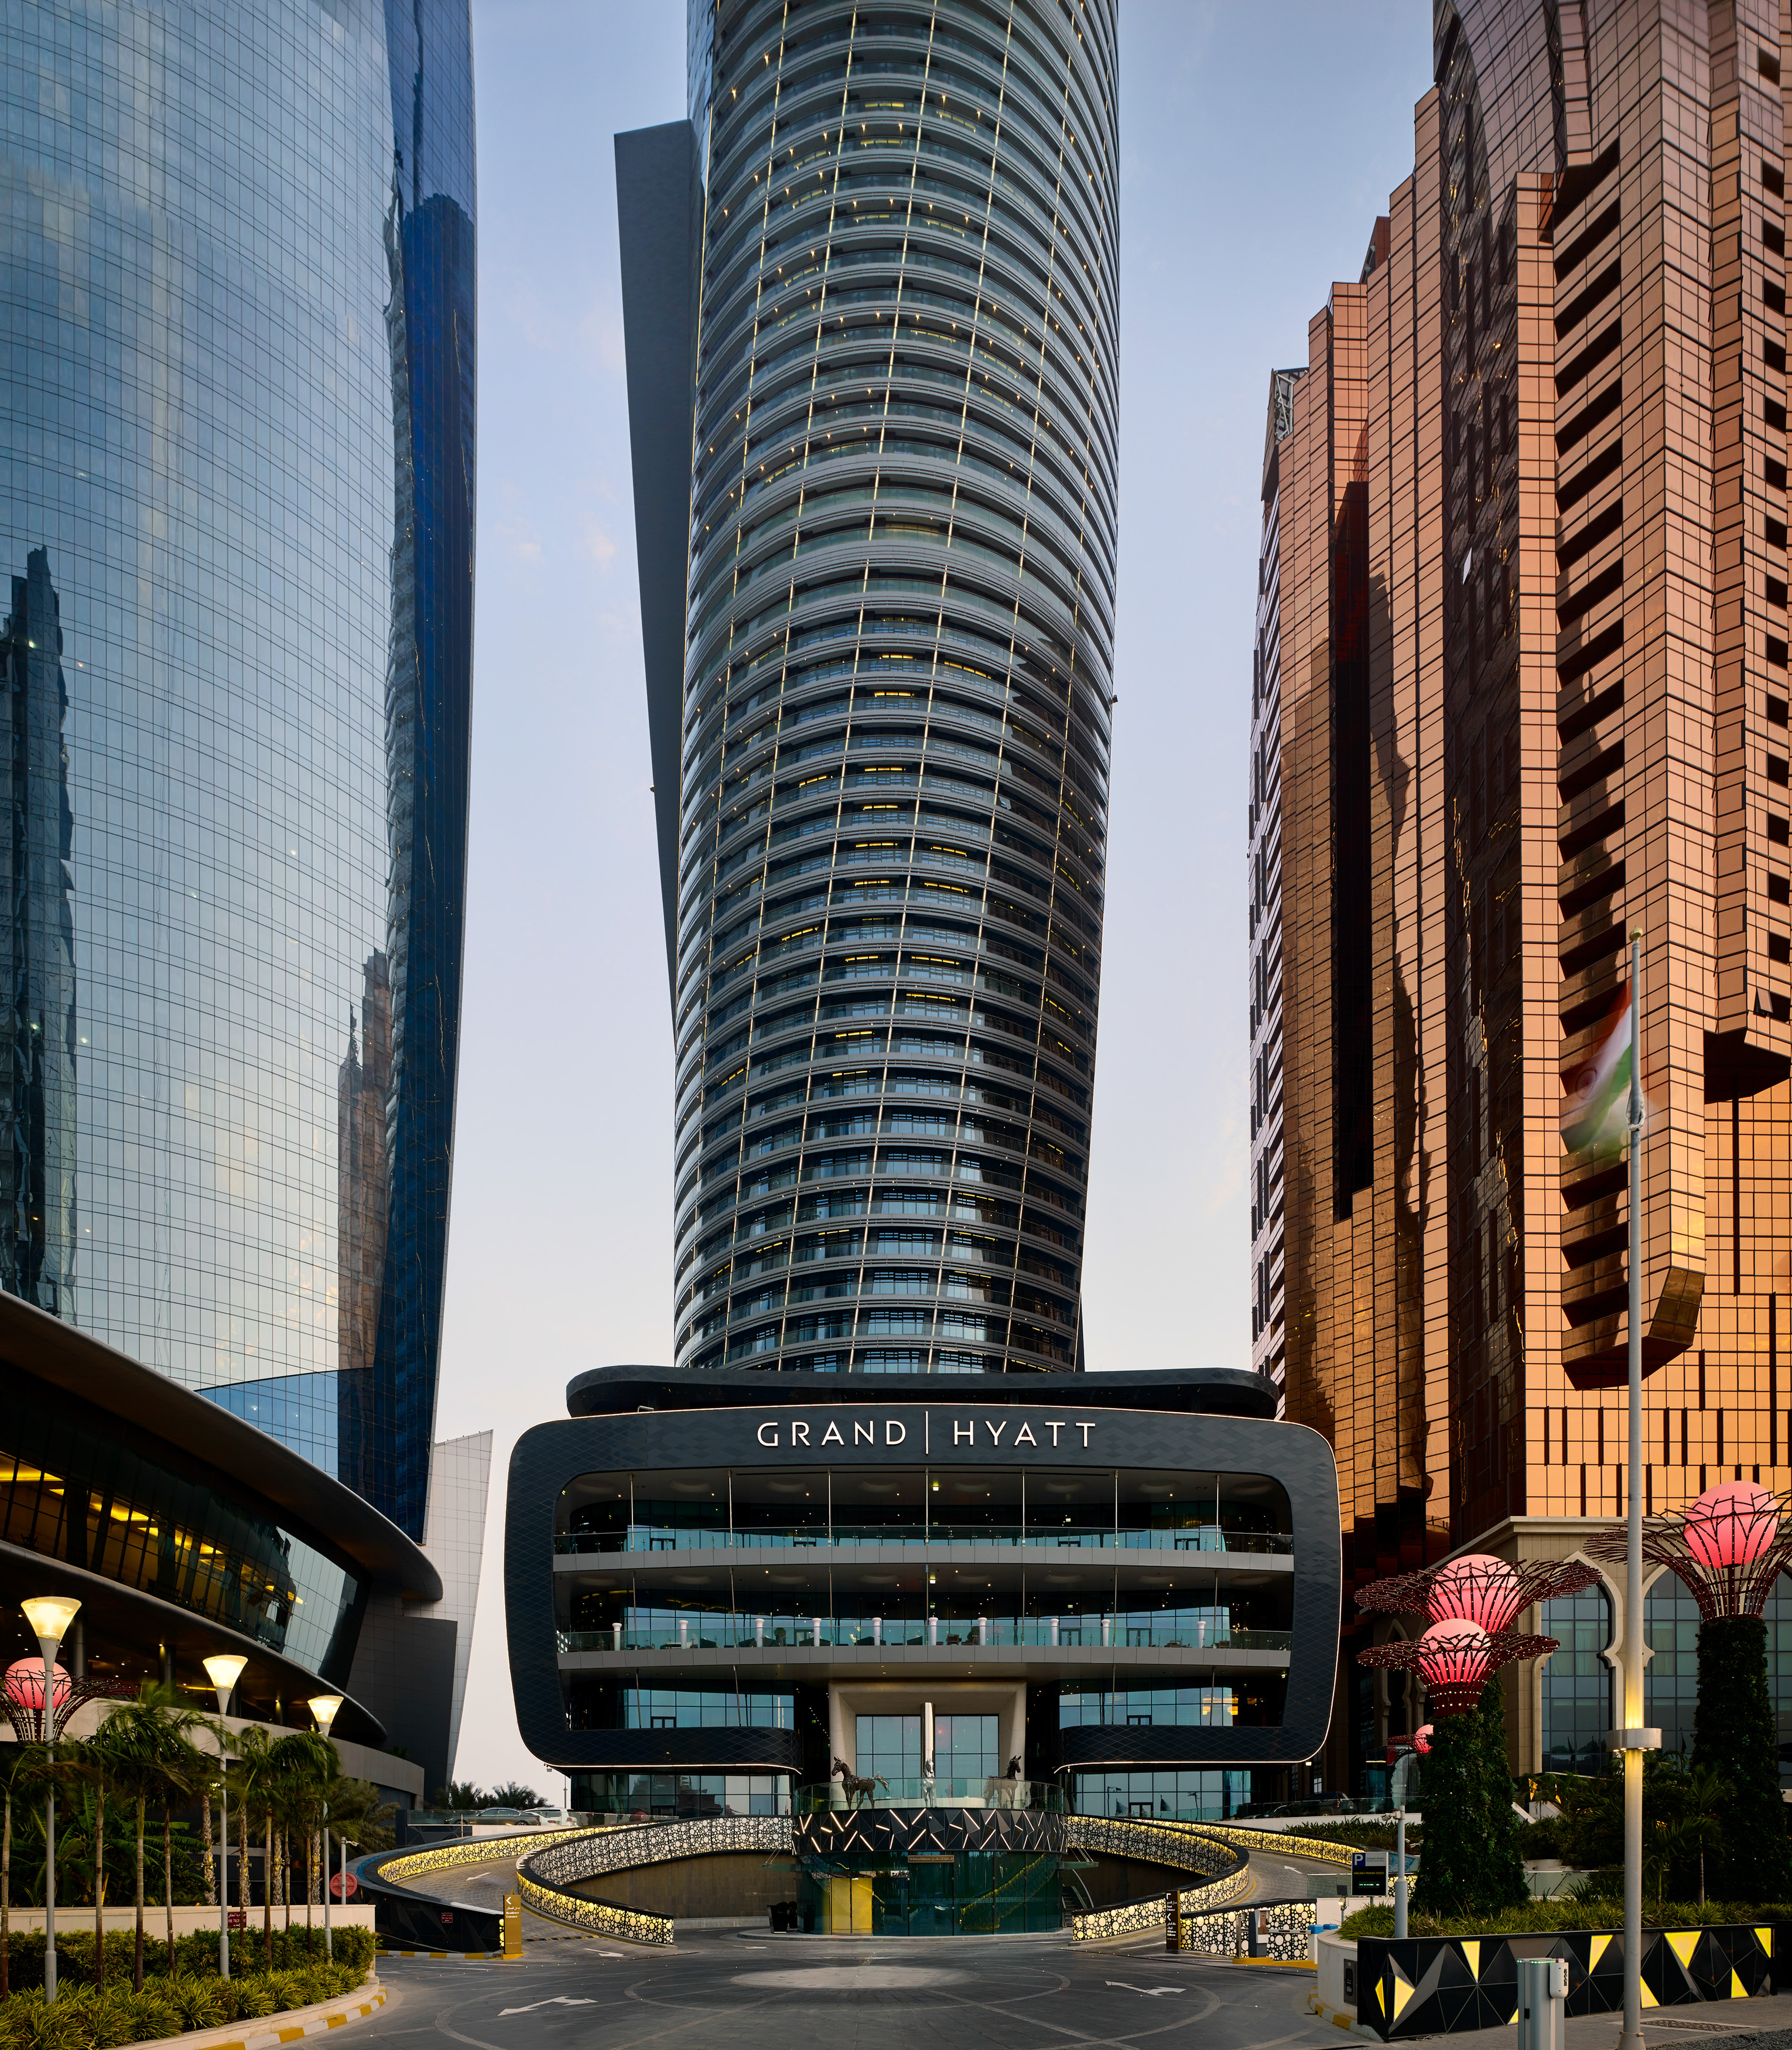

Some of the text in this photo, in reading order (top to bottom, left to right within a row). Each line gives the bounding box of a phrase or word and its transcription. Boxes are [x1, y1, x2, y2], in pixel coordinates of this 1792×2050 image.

[757, 1420, 1096, 1447] GRAND HYATT
[1354, 1854, 1363, 1866] P
